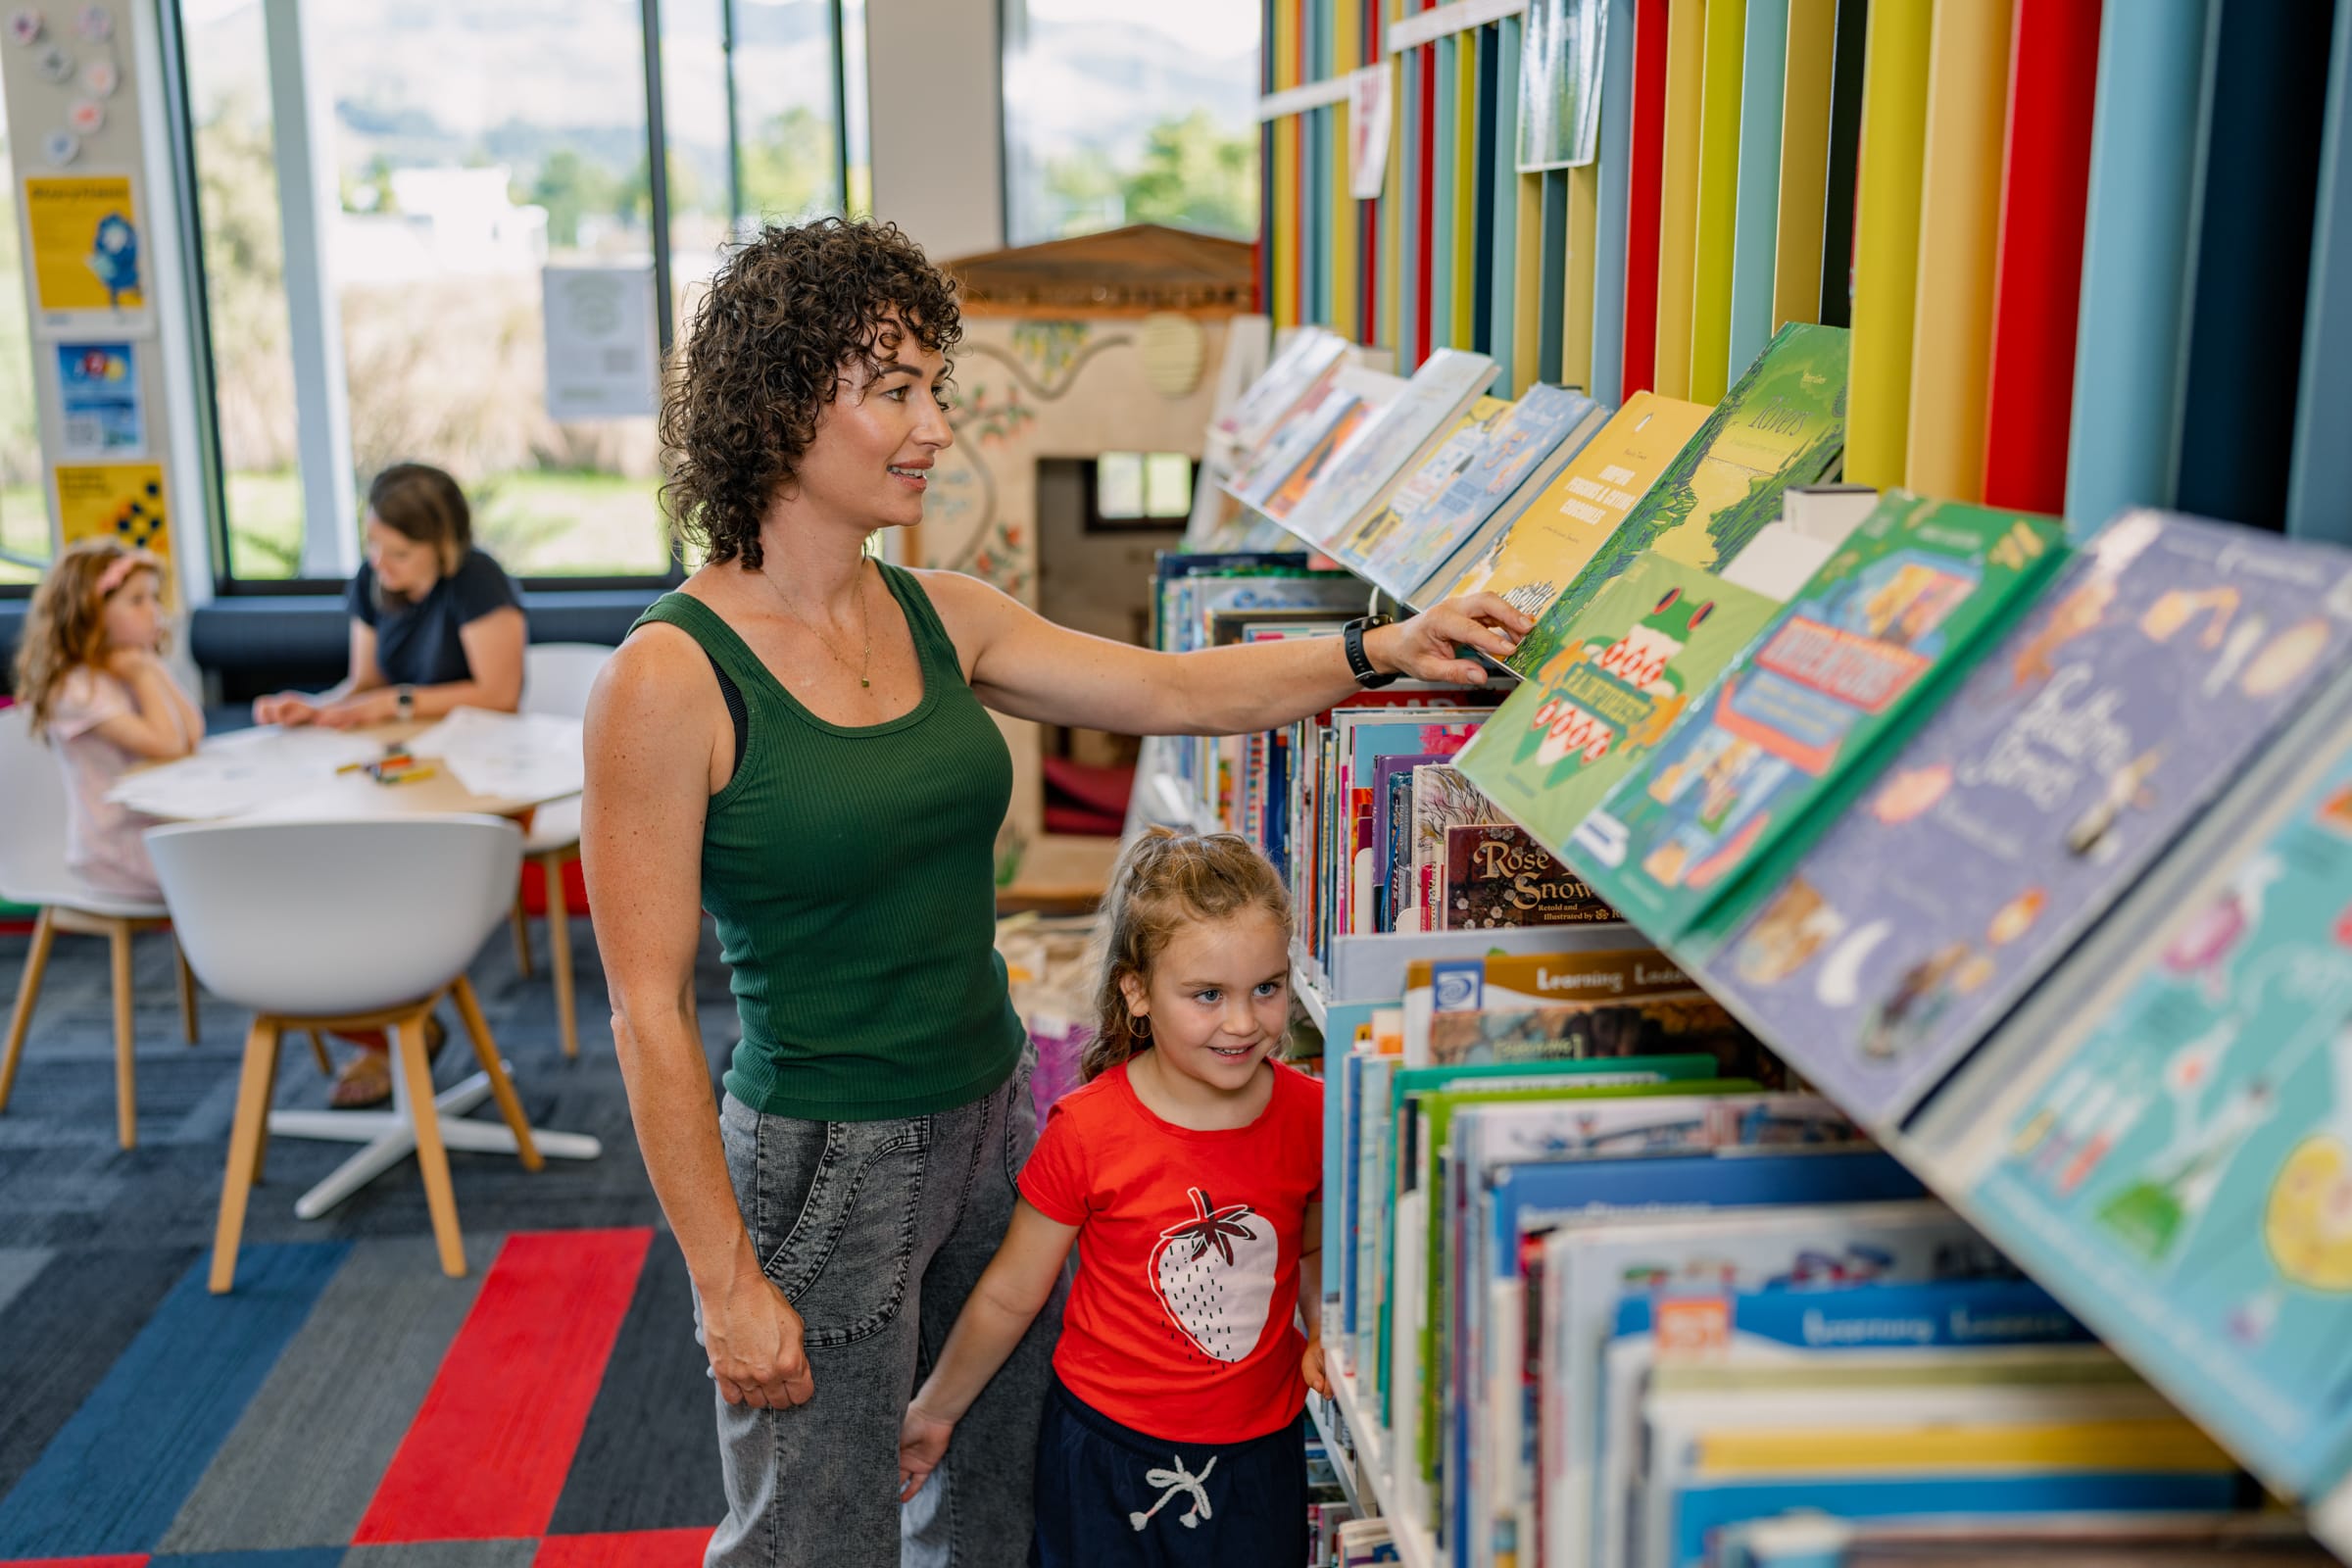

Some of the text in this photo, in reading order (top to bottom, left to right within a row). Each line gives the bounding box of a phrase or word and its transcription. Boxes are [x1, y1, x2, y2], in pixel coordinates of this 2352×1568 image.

[1747, 394, 1814, 437] Rivers
[1473, 841, 1551, 879] Rose
[1544, 911, 1583, 920] Illustrated
[1584, 911, 1593, 921] by
[1536, 966, 1624, 994] Learning
